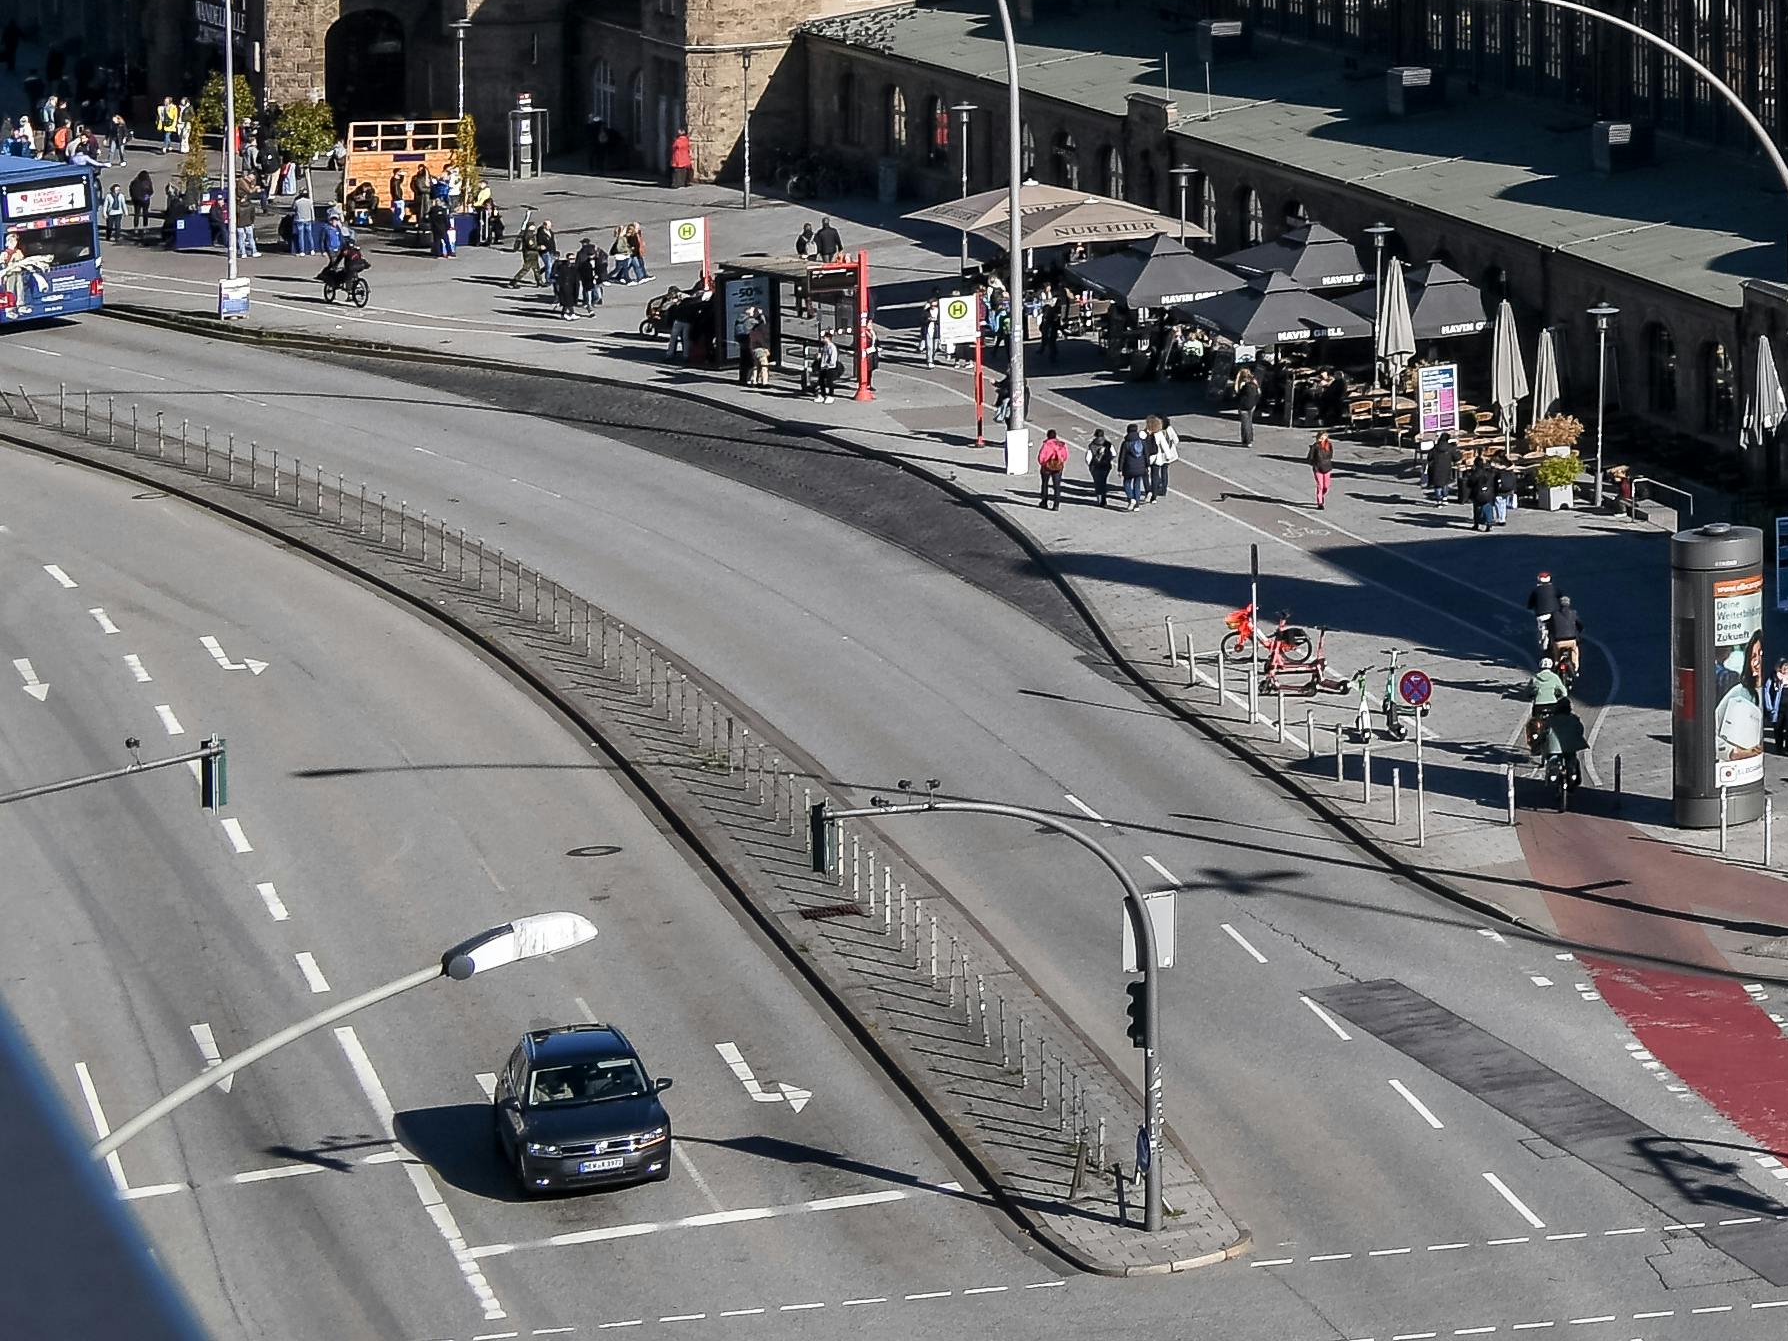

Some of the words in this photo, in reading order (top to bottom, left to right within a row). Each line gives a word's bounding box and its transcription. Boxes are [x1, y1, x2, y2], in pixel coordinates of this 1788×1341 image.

[1053, 225, 1101, 237] NUR
[1103, 221, 1158, 234] HIER
[1313, 327, 1345, 338] GRILL
[1716, 601, 1740, 610] Deine
[1716, 623, 1742, 631] Deine
[1716, 631, 1750, 642] Zukunft
